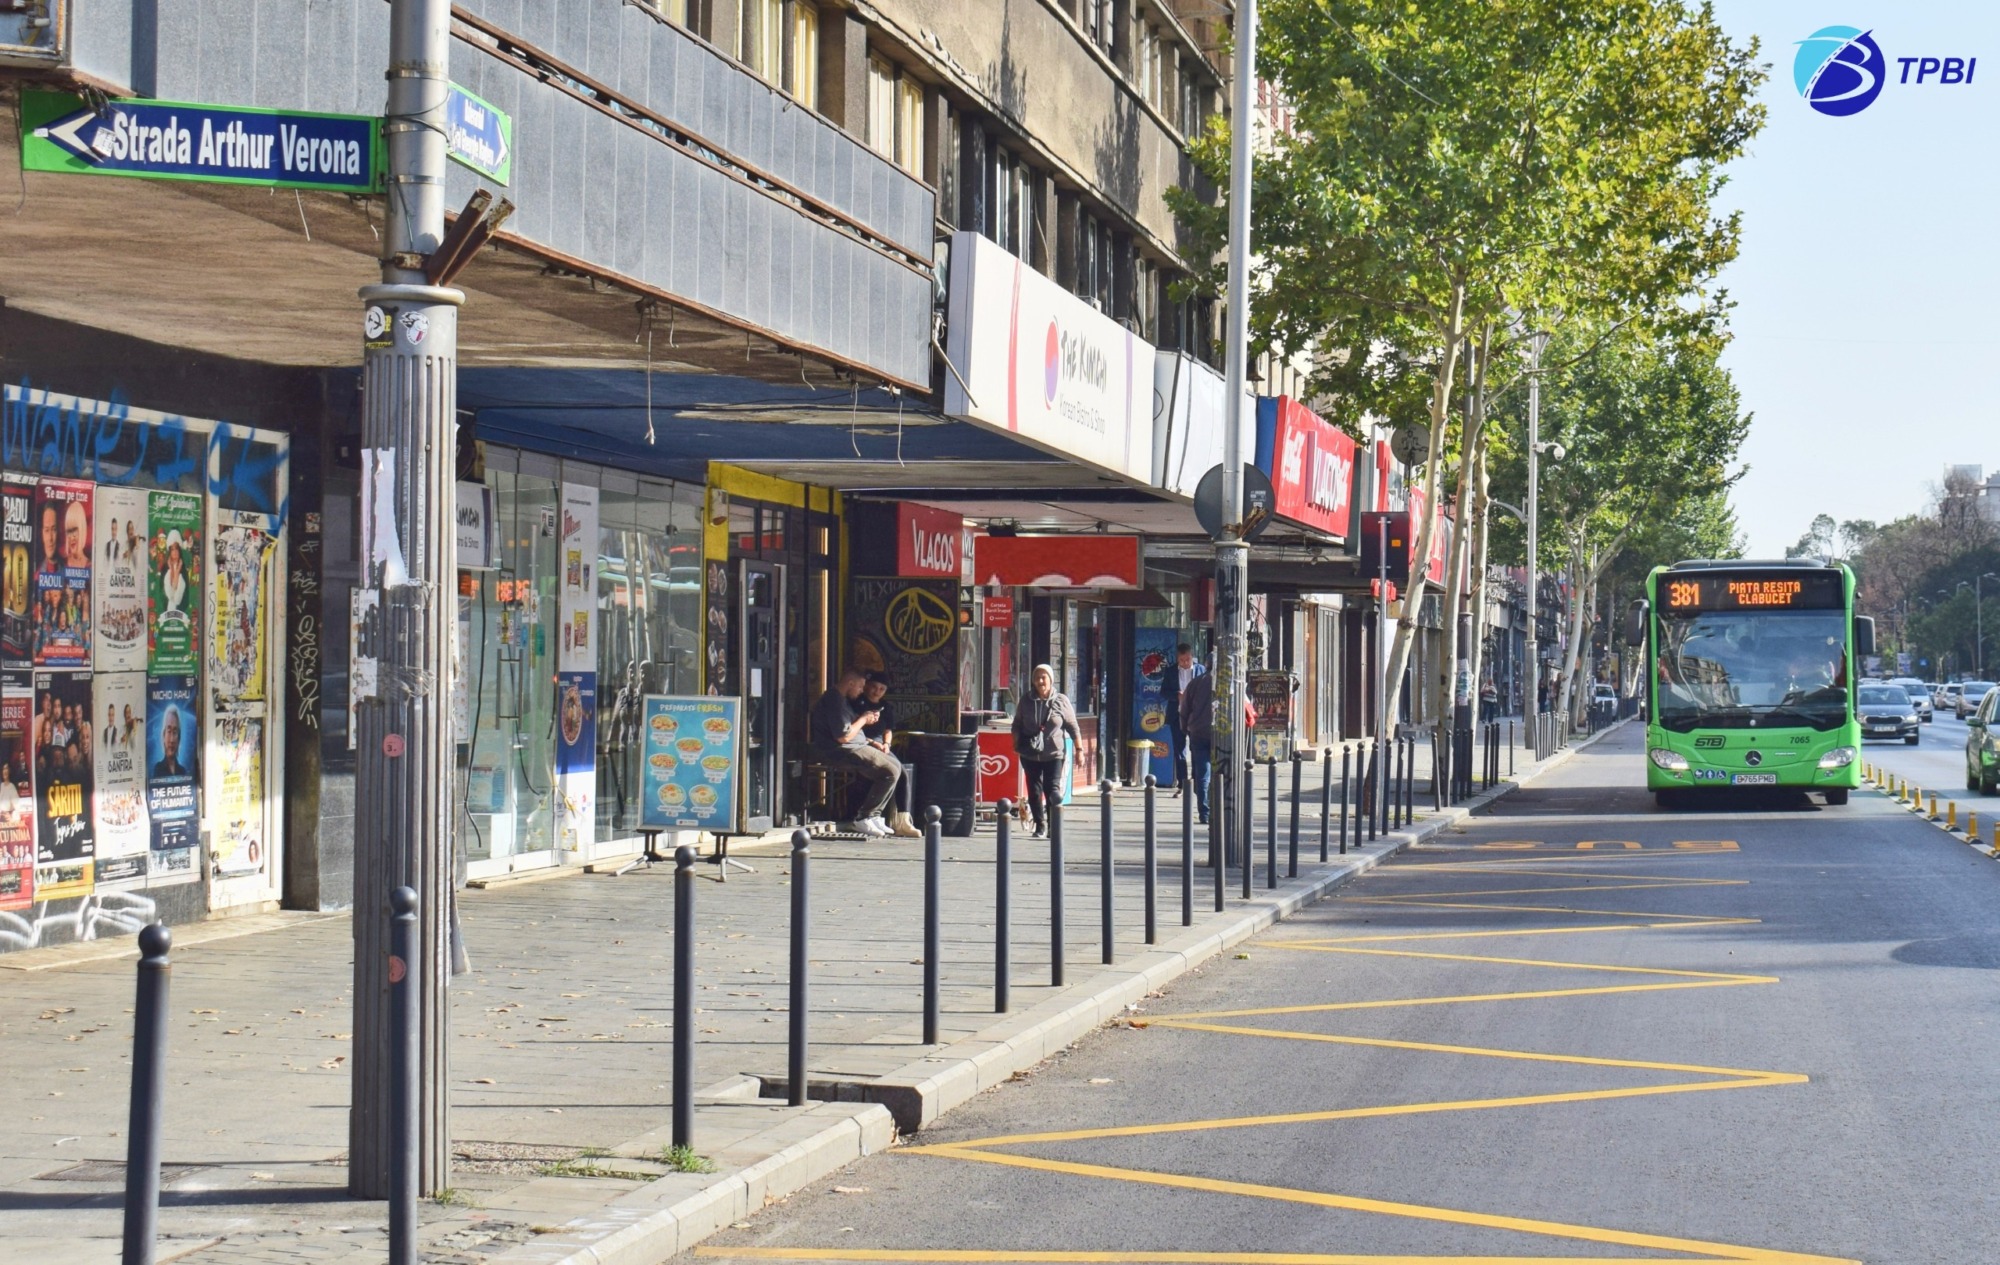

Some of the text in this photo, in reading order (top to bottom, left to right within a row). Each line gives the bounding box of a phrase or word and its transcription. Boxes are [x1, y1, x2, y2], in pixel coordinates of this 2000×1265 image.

[114, 111, 361, 175] Strada Arthur Verona
[1061, 329, 1107, 394] THE KIMCHI
[912, 518, 954, 573] VLACOS
[39, 574, 63, 588] RAOUL
[1670, 582, 1800, 606] 381 PIATA RESITA
[1738, 593, 1793, 605] CLABUCET
[1143, 685, 1162, 693] pep
[1694, 737, 1723, 748] STB
[1790, 736, 1810, 744] 7065
[152, 785, 192, 798] THE FUTURE
[150, 796, 194, 810] OF HUMANITY
